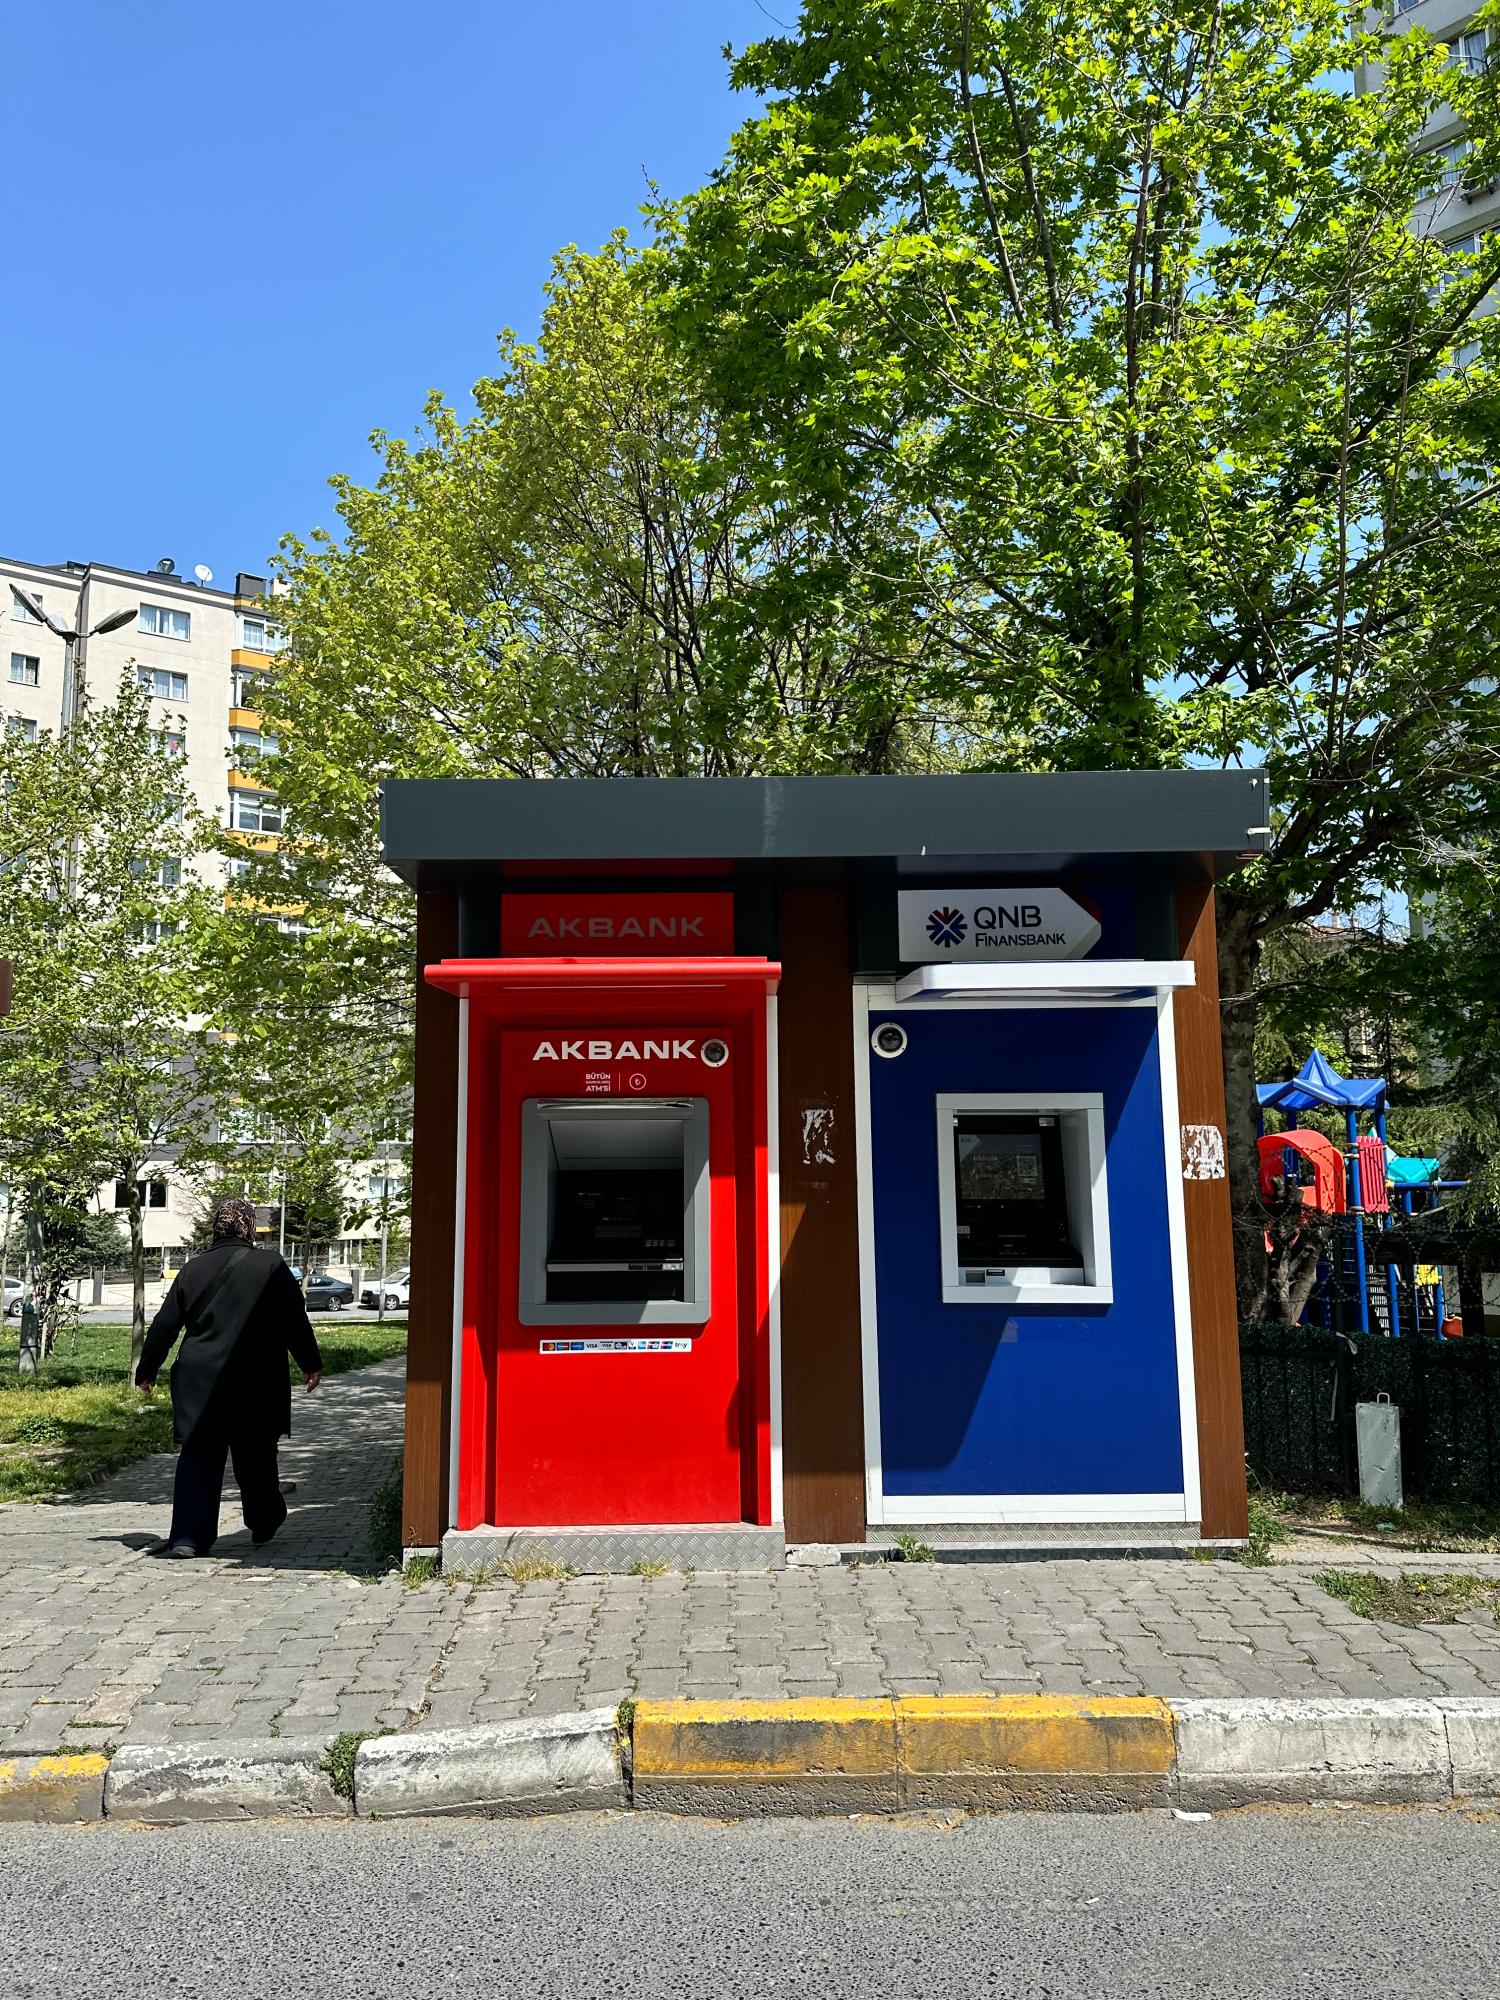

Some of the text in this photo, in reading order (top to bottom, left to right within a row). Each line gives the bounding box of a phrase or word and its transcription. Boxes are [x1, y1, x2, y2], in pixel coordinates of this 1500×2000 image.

[527, 916, 705, 938] AKBANK
[973, 905, 1042, 930] QNB
[532, 1039, 696, 1061] AKBANK
